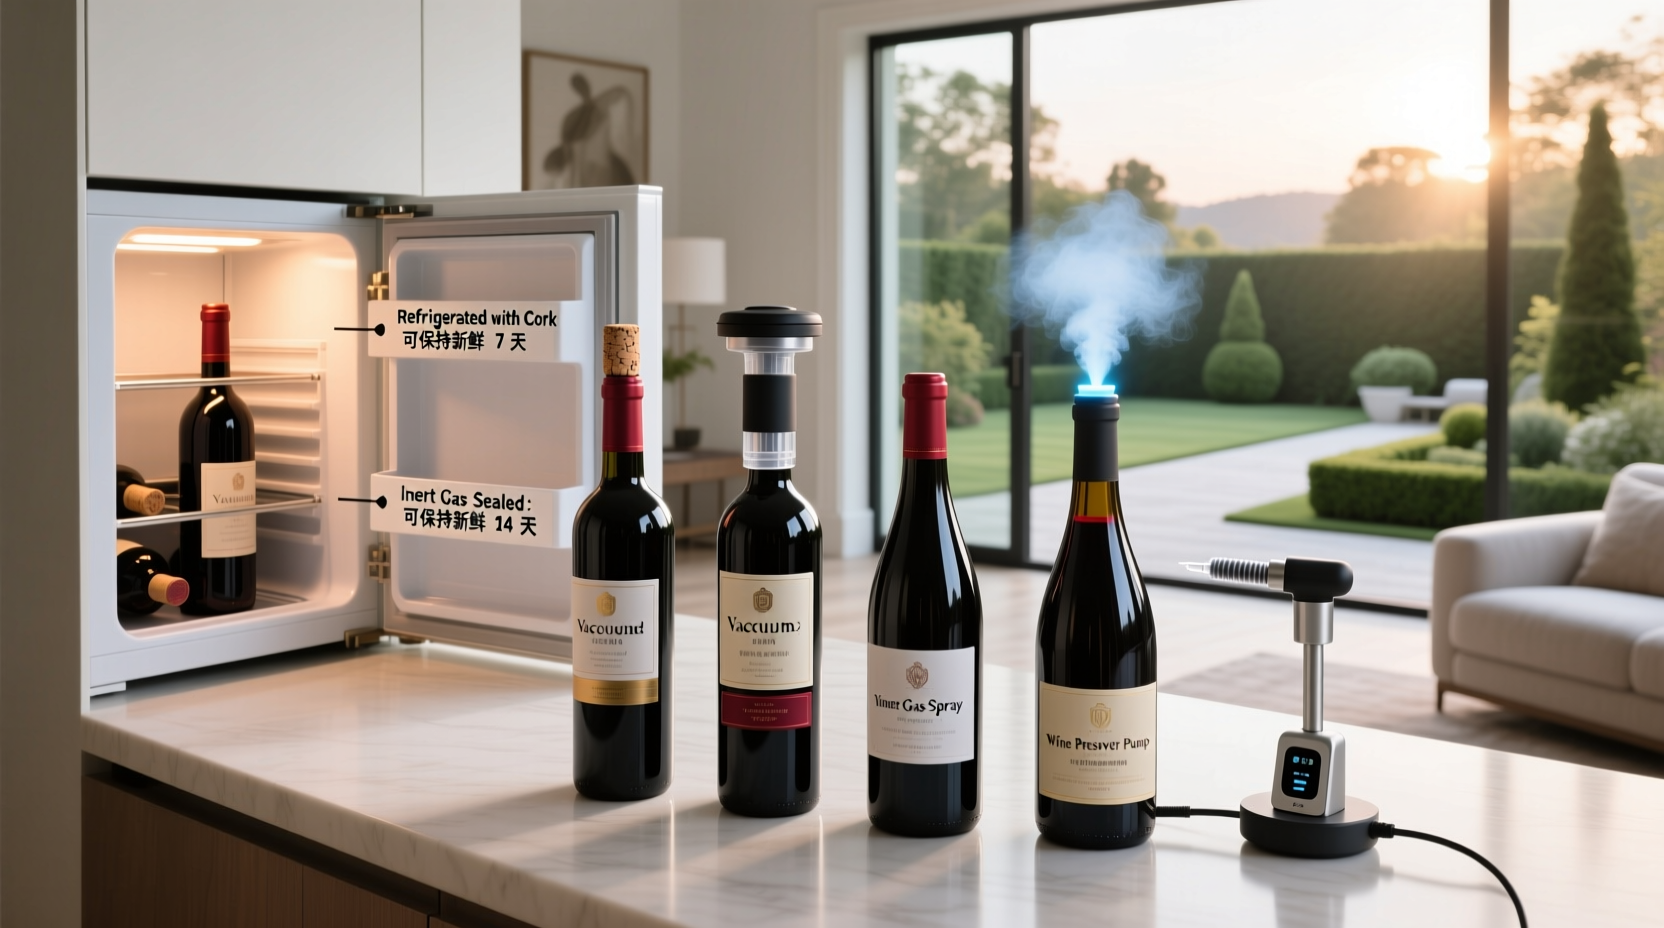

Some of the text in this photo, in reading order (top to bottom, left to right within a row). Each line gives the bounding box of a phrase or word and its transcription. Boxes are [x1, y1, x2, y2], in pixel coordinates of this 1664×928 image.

[397, 308, 557, 329] Refrigerated with Cork
[495, 333, 505, 349] 7
[510, 332, 526, 351] 天
[401, 485, 436, 503] Inert
[473, 491, 532, 512] Sealed:
[495, 515, 513, 533] 14
[520, 516, 537, 536] 天
[928, 699, 963, 716] Spray
[1046, 733, 1072, 749] Wine
[1123, 737, 1150, 750] Pump
